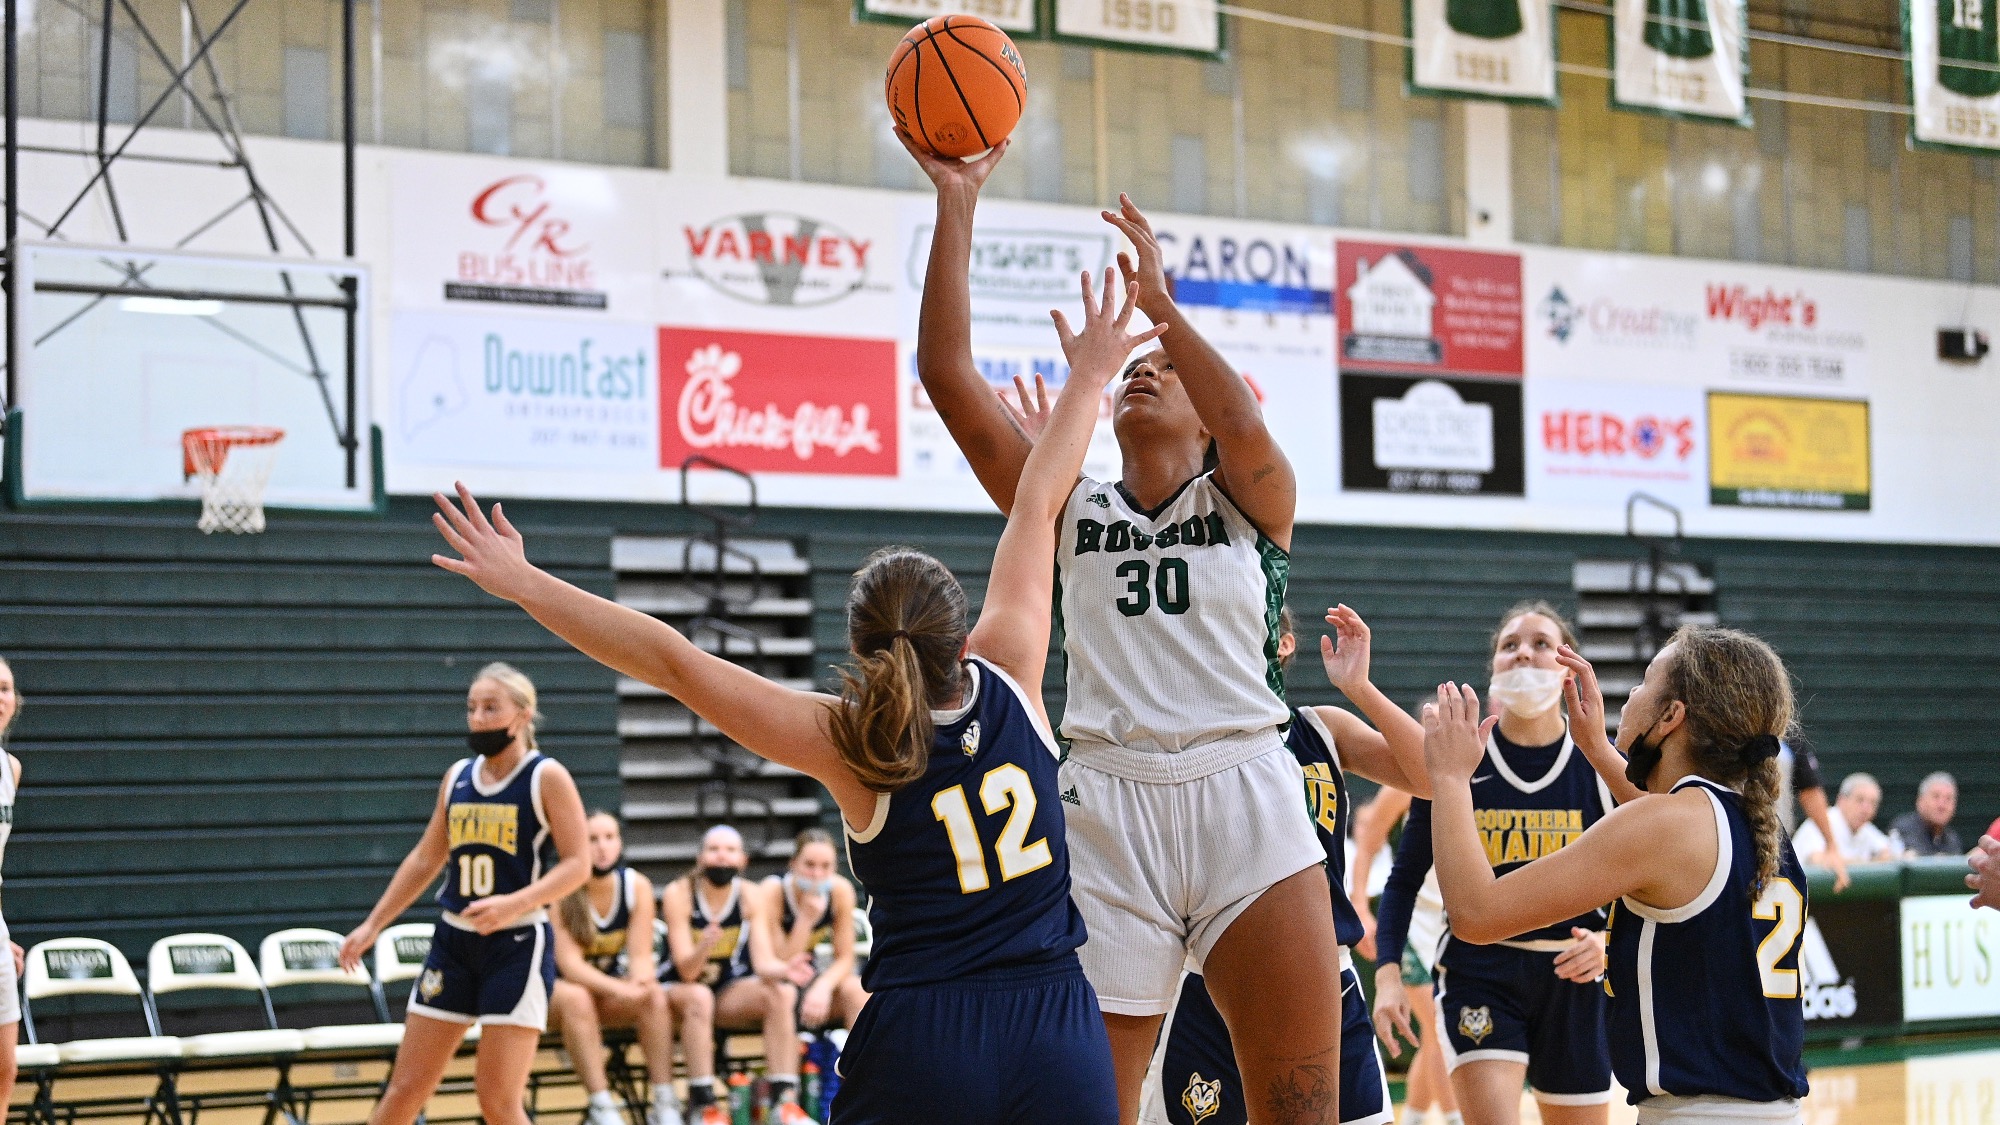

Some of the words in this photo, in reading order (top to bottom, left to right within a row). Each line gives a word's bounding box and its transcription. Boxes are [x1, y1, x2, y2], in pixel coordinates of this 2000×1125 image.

[1102, 0, 1176, 33] 1990
[1455, 51, 1510, 84] 1991
[682, 224, 871, 269] VARNEY
[1155, 231, 1309, 287] CARON
[458, 251, 524, 282] BUS
[528, 257, 597, 288] LINE
[1706, 282, 1817, 333] Wight's
[484, 332, 648, 398] DownEast
[1541, 410, 1694, 461] HERO'S
[1116, 557, 1190, 617] 30
[931, 762, 1053, 894] 12
[1474, 809, 1583, 830] SOUTHERN
[458, 854, 495, 897] 10
[173, 947, 231, 967] HUSSON
[1752, 877, 1808, 998] 2
[48, 951, 109, 971] HUSSON
